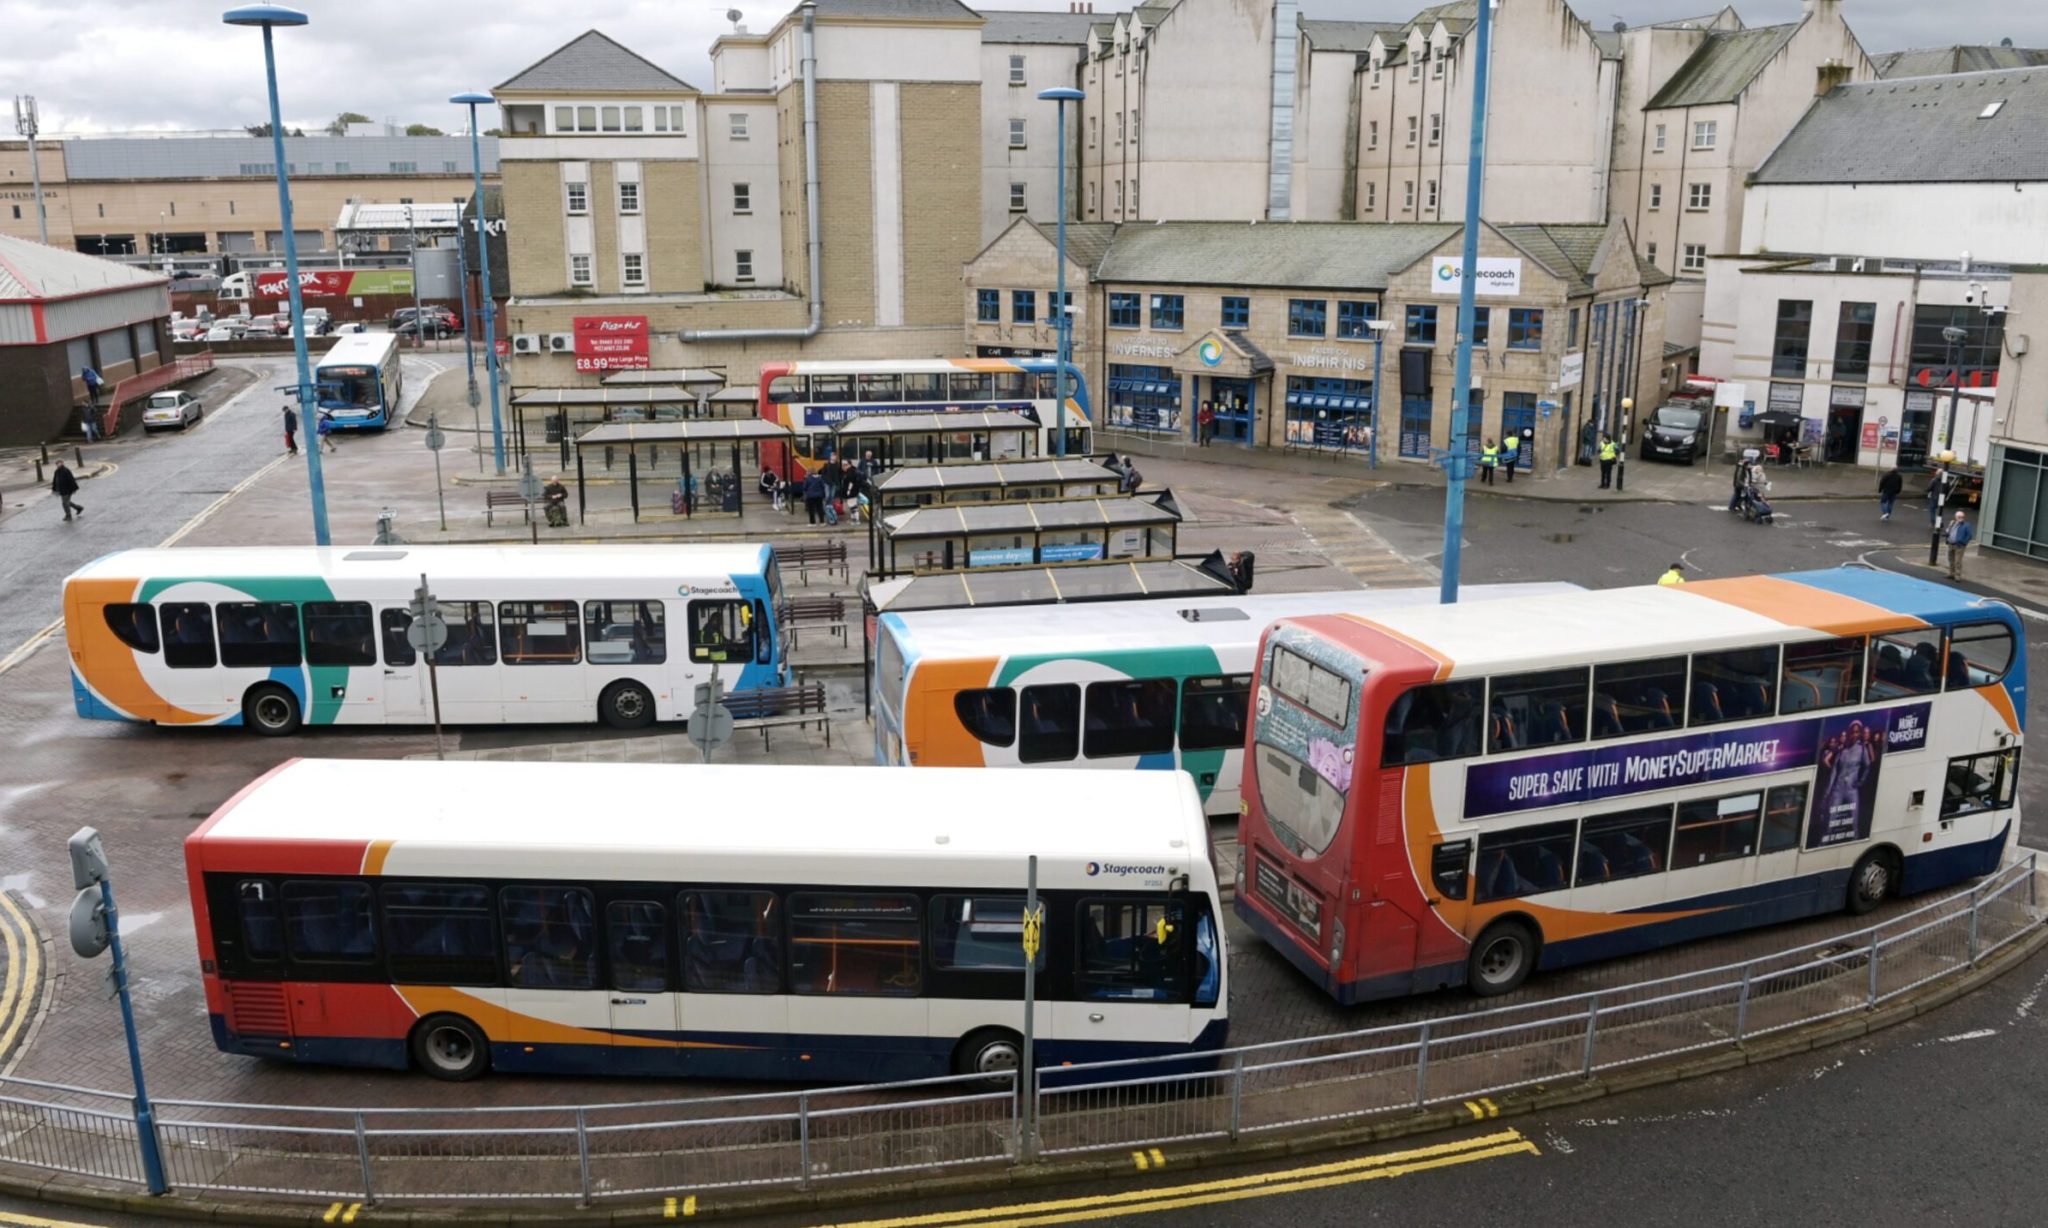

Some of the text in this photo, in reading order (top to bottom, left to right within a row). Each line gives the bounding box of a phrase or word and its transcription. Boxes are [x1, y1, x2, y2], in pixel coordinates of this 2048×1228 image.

[1454, 267, 1515, 279] Secoach
[600, 321, 641, 331] Pizza Hut
[576, 358, 608, 369] £8.99
[1343, 356, 1366, 371] NIS
[823, 410, 846, 422] WHAT
[690, 586, 738, 595] Stagecoach
[1509, 772, 1549, 801] SUPER
[1552, 767, 1584, 795] SAVE
[1587, 762, 1620, 788] WITH
[1103, 863, 1166, 876] Stagecoach
